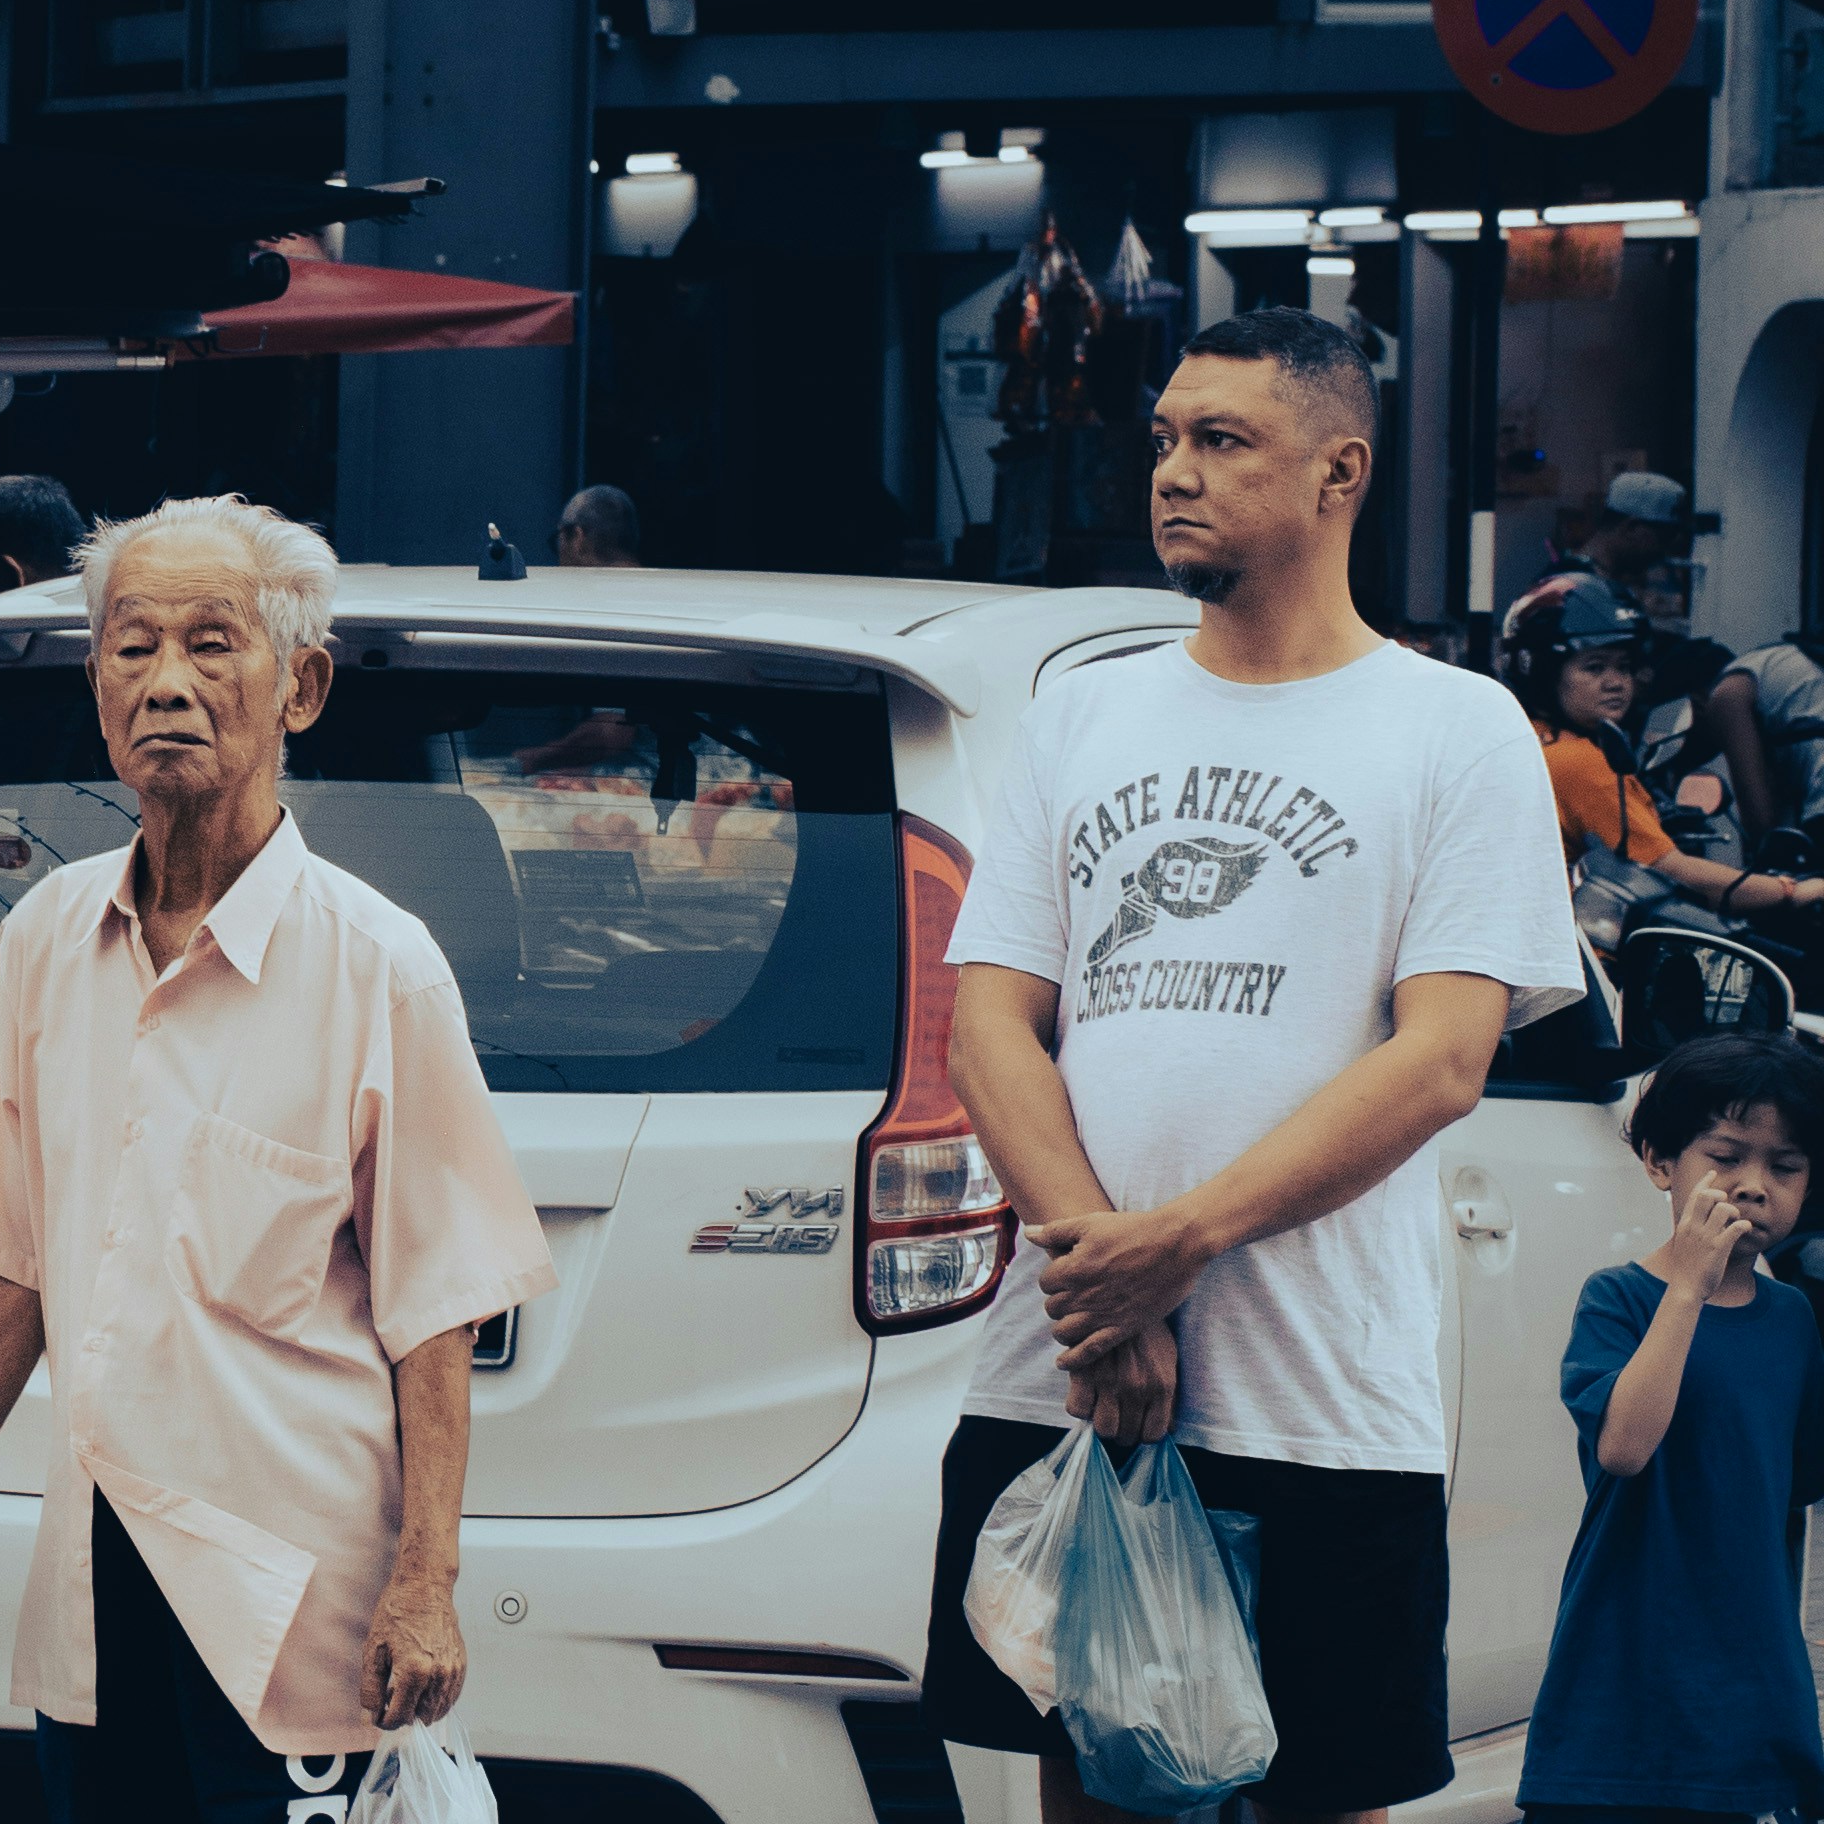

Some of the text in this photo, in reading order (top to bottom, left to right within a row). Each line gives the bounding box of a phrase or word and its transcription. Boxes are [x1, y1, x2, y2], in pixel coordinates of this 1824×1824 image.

[1070, 766, 1359, 889] STATE ATHLETIC
[1076, 959, 1287, 1024] CROSS COUNTRY
